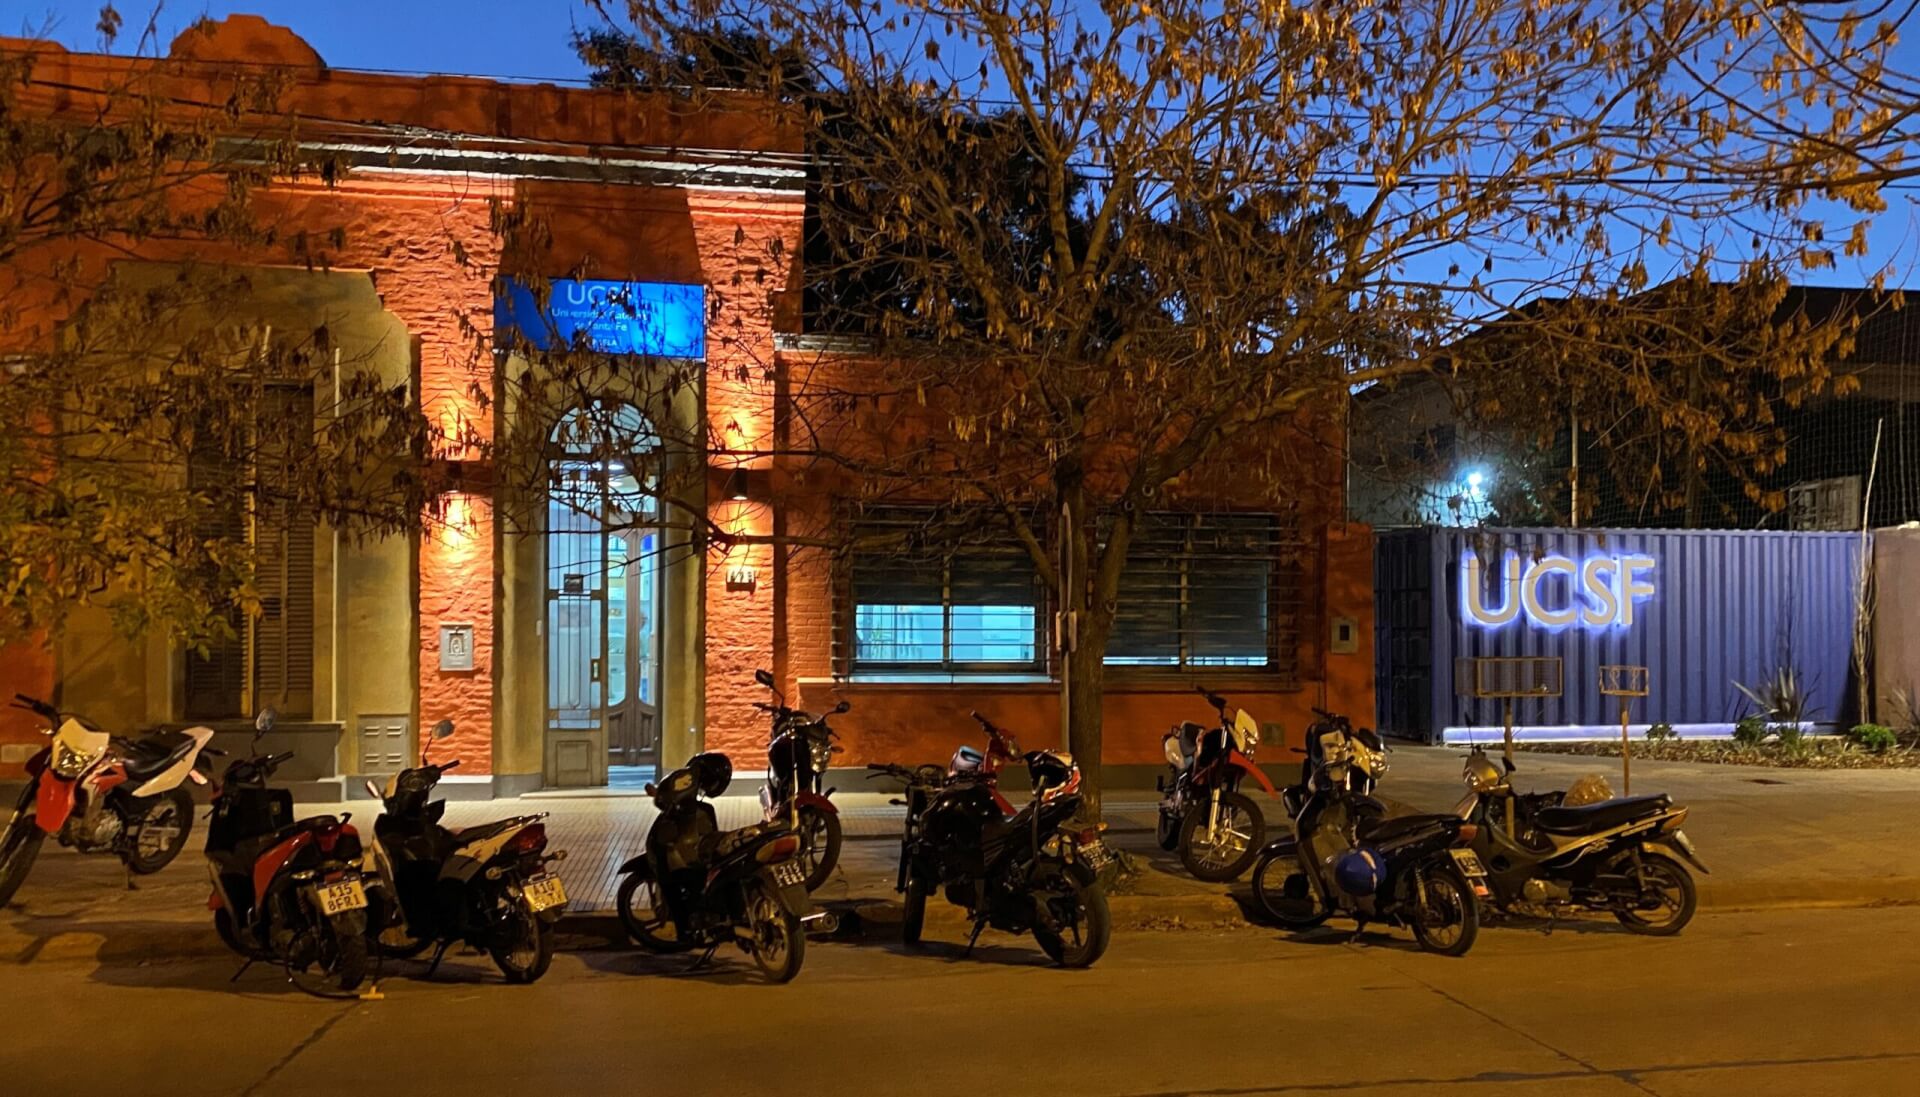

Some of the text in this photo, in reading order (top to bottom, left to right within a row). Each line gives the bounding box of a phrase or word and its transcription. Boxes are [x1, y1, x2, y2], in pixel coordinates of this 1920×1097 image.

[567, 284, 631, 306] UCS
[615, 322, 628, 332] Fe
[1467, 558, 1656, 625] UCSF
[328, 883, 352, 898] A15
